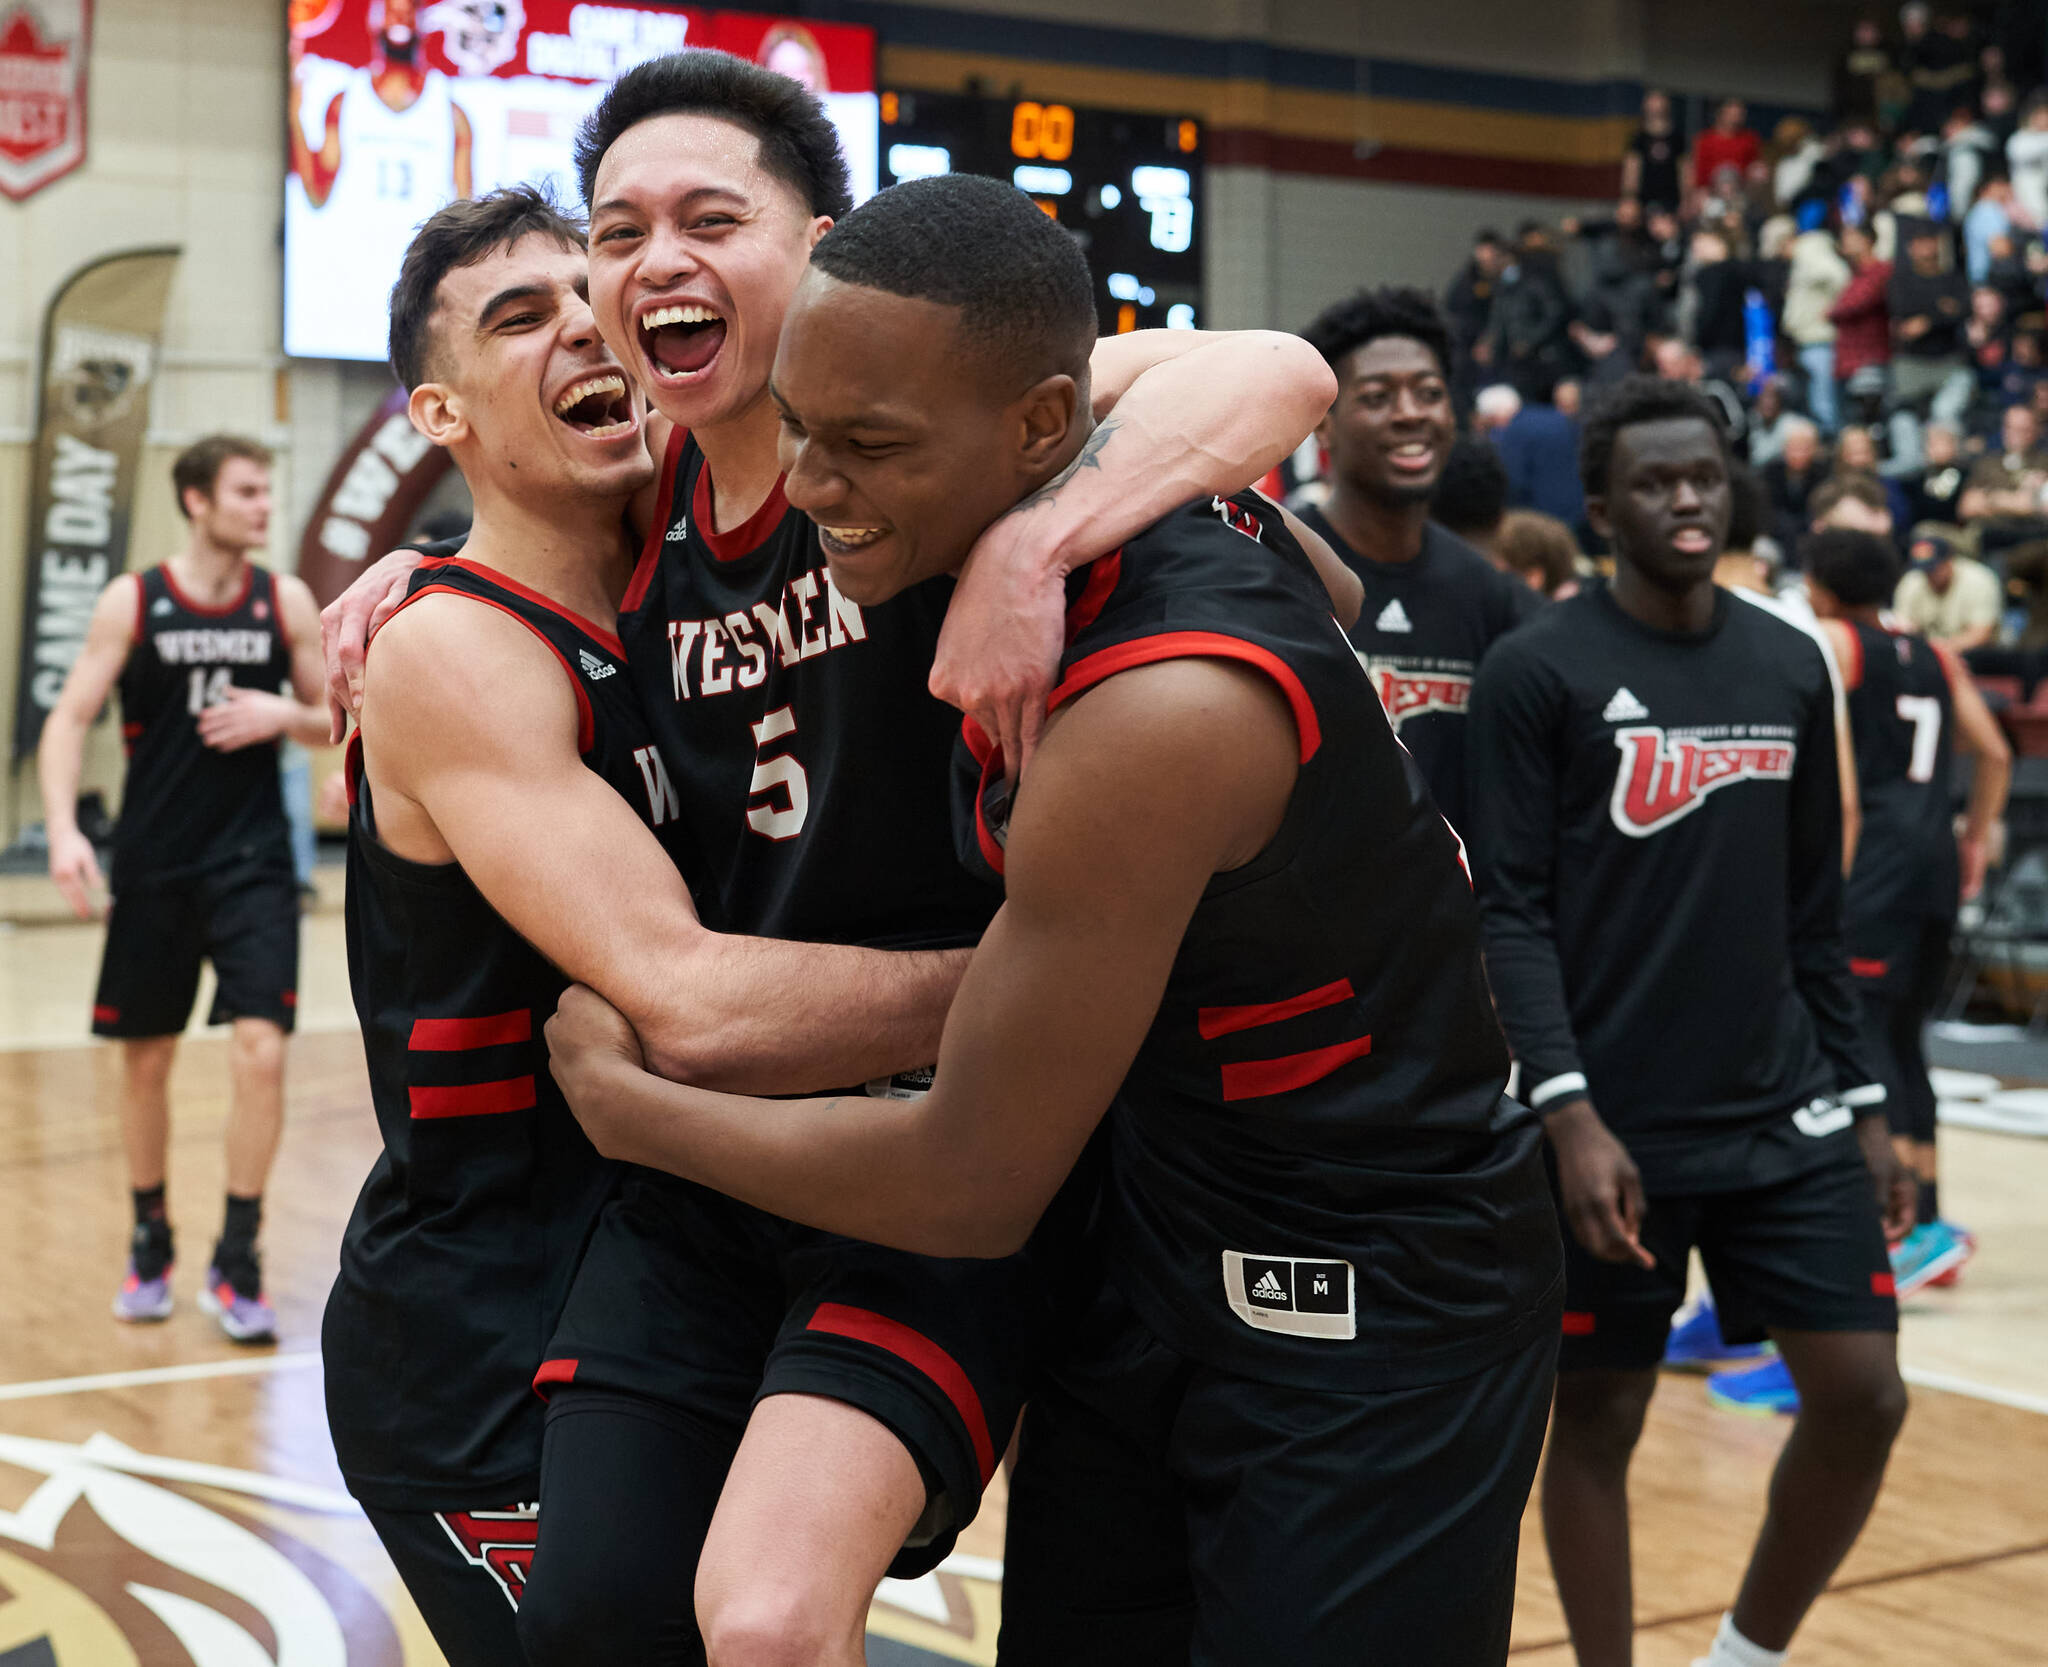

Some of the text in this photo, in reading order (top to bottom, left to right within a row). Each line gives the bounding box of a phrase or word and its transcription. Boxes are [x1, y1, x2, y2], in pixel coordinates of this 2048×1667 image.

[44, 432, 118, 547] DAY
[667, 566, 868, 702] WESMEN
[746, 703, 809, 842] 5
[1896, 695, 1942, 784] 7
[1251, 1288, 1288, 1301] adidas
[1313, 1280, 1328, 1295] M
